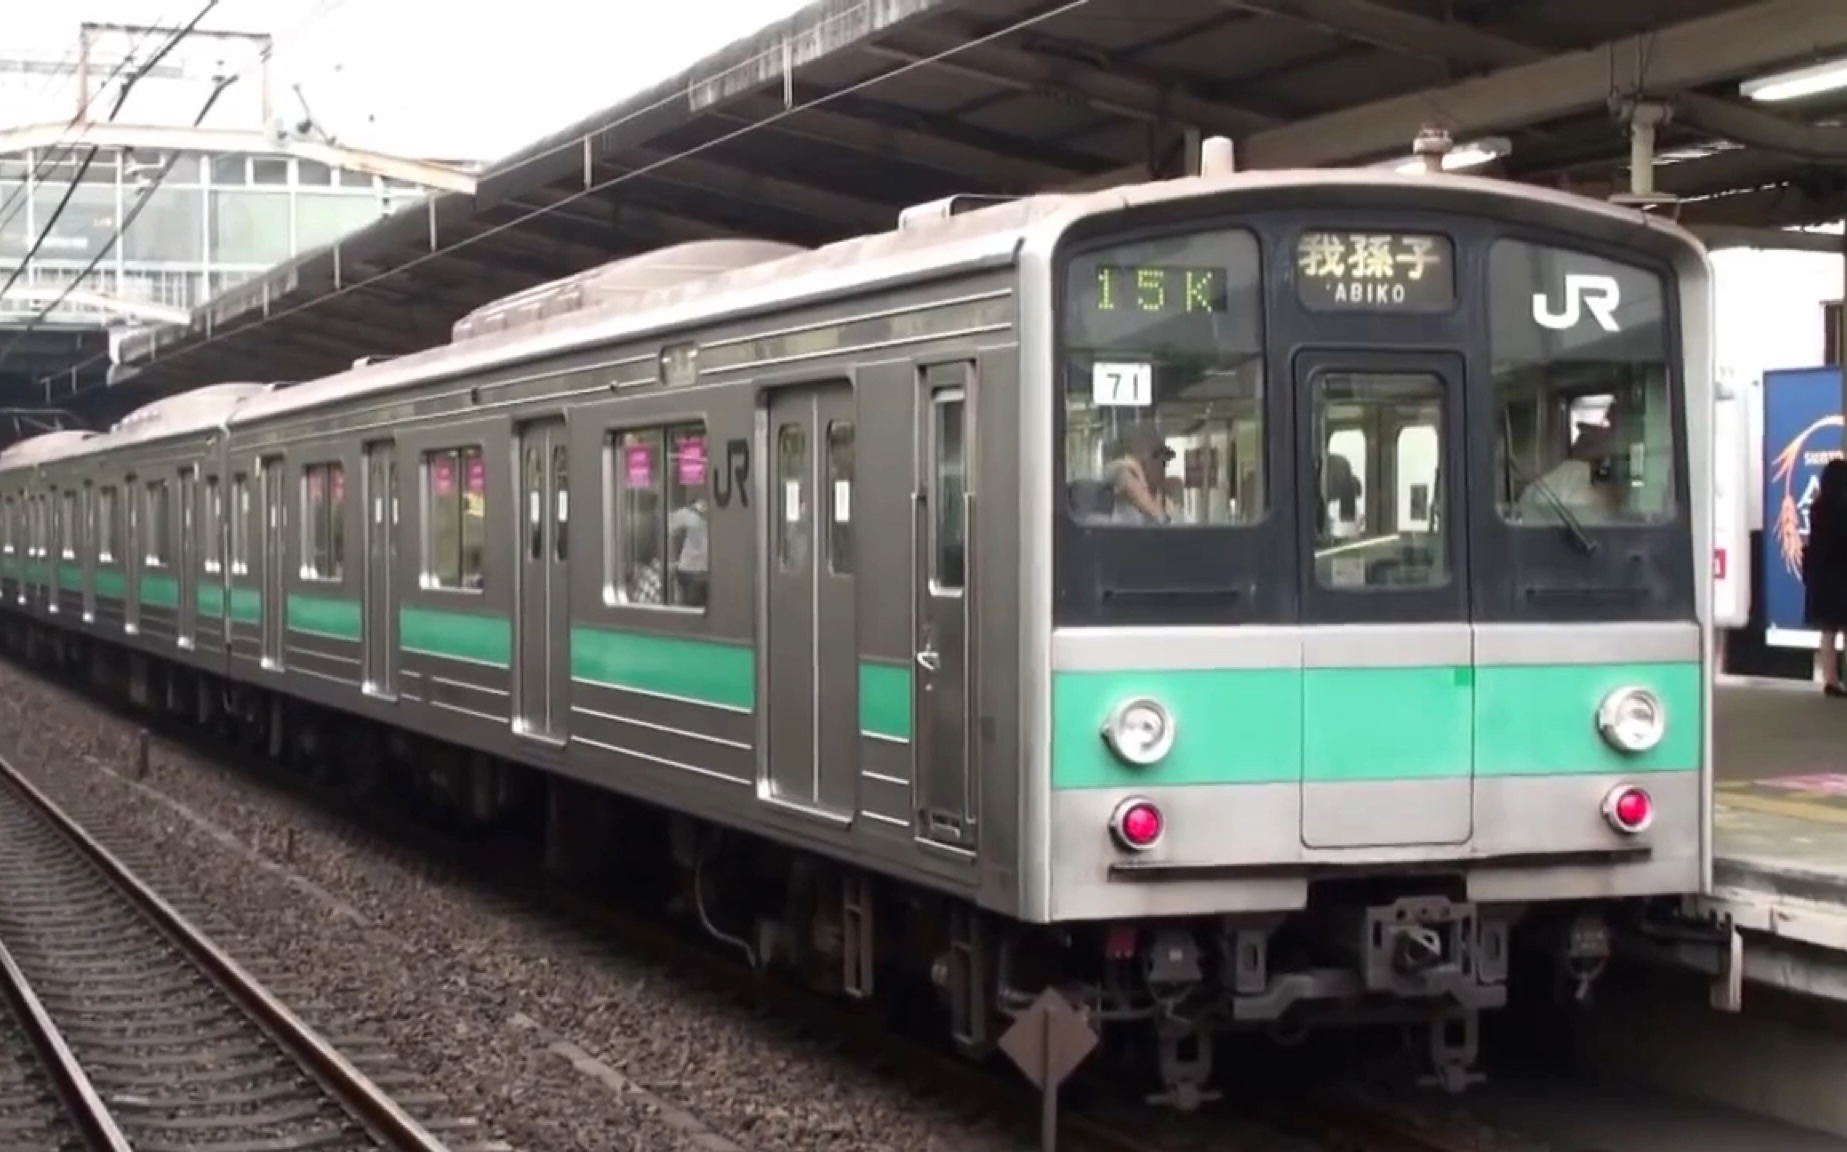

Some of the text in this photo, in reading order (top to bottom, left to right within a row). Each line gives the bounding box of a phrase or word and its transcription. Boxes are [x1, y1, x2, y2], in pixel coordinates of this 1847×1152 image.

[1298, 234, 1440, 280] 我孫子
[1334, 282, 1405, 303] ABIKO
[1532, 273, 1621, 332] JR
[1106, 373, 1139, 400] 71
[713, 437, 749, 510] JR
